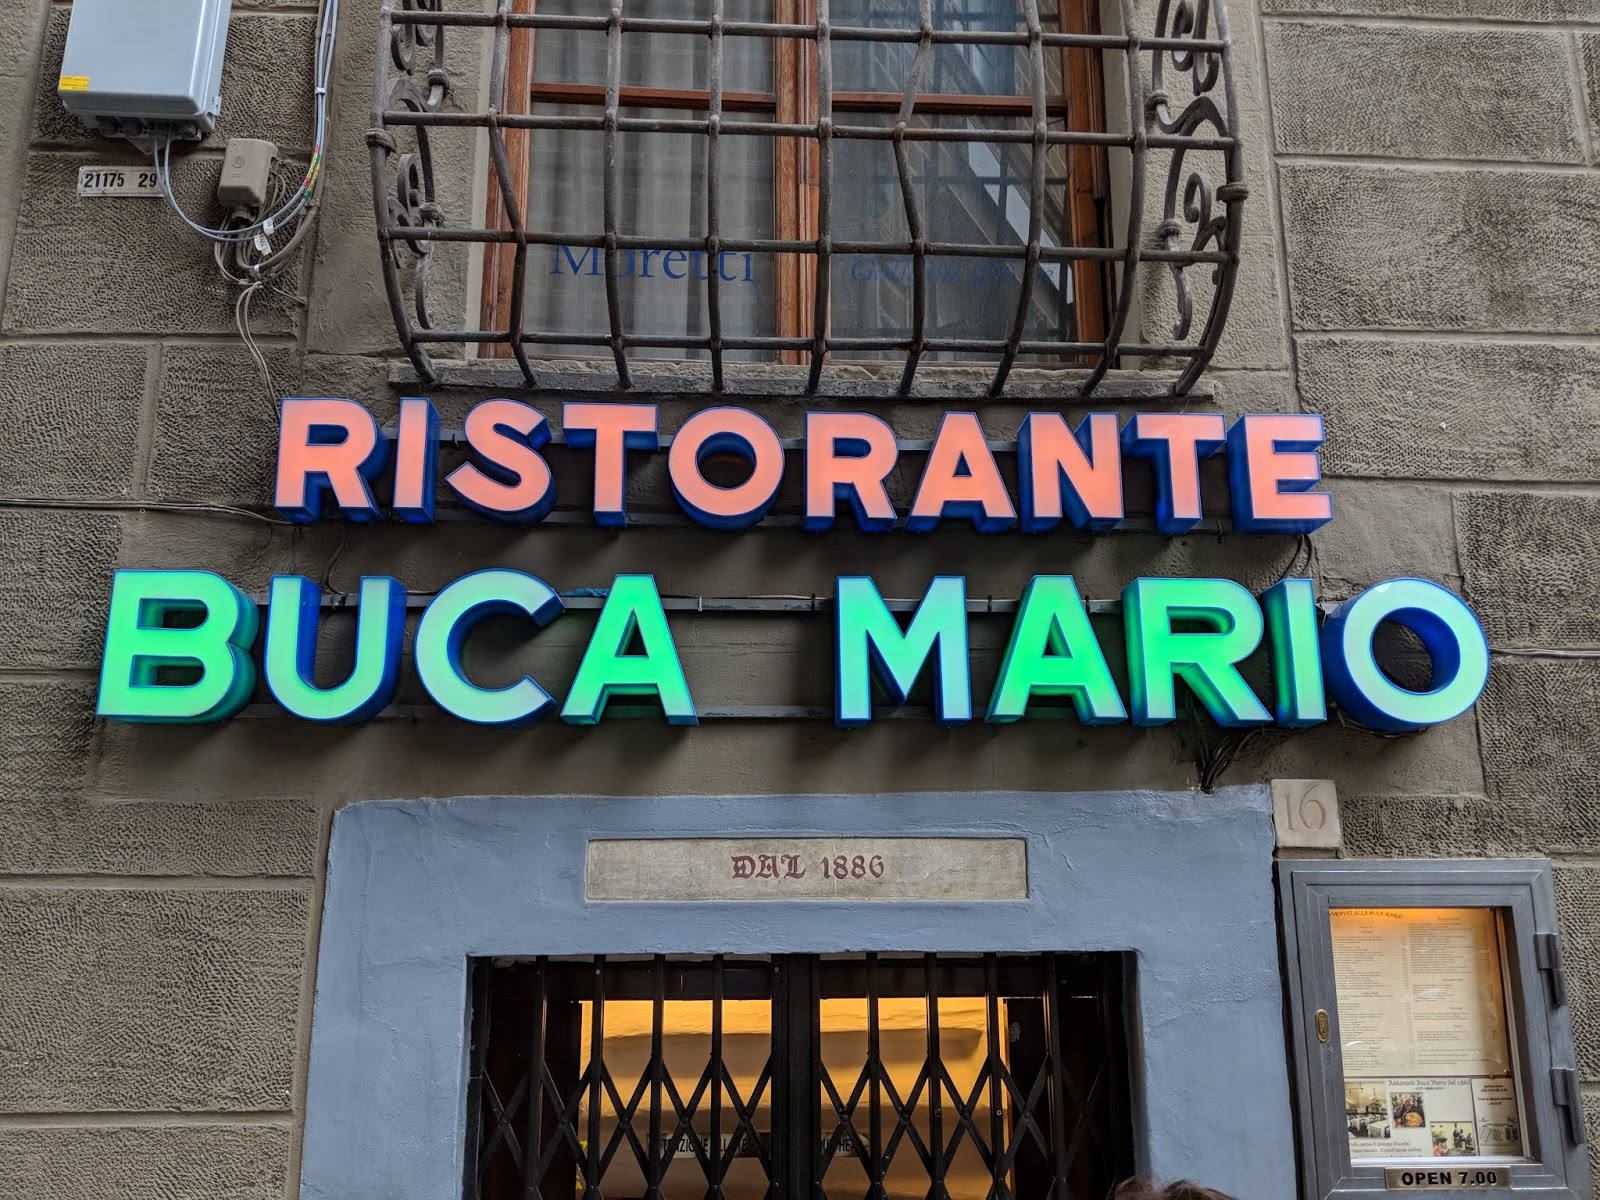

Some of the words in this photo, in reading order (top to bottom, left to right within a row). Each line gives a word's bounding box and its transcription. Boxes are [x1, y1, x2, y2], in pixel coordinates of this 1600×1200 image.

[83, 172, 124, 188] 21175
[138, 172, 158, 188] 29
[549, 243, 755, 282] Moretti
[274, 397, 1334, 534] RISTORANTE
[96, 568, 699, 726] BUCA
[835, 575, 1490, 732] MARIO
[1284, 784, 1327, 832] 16
[730, 854, 806, 879] DAL
[819, 854, 885, 879] 1886
[1401, 1172, 1452, 1186] OPEN
[1458, 1171, 1497, 1184] 7.00
